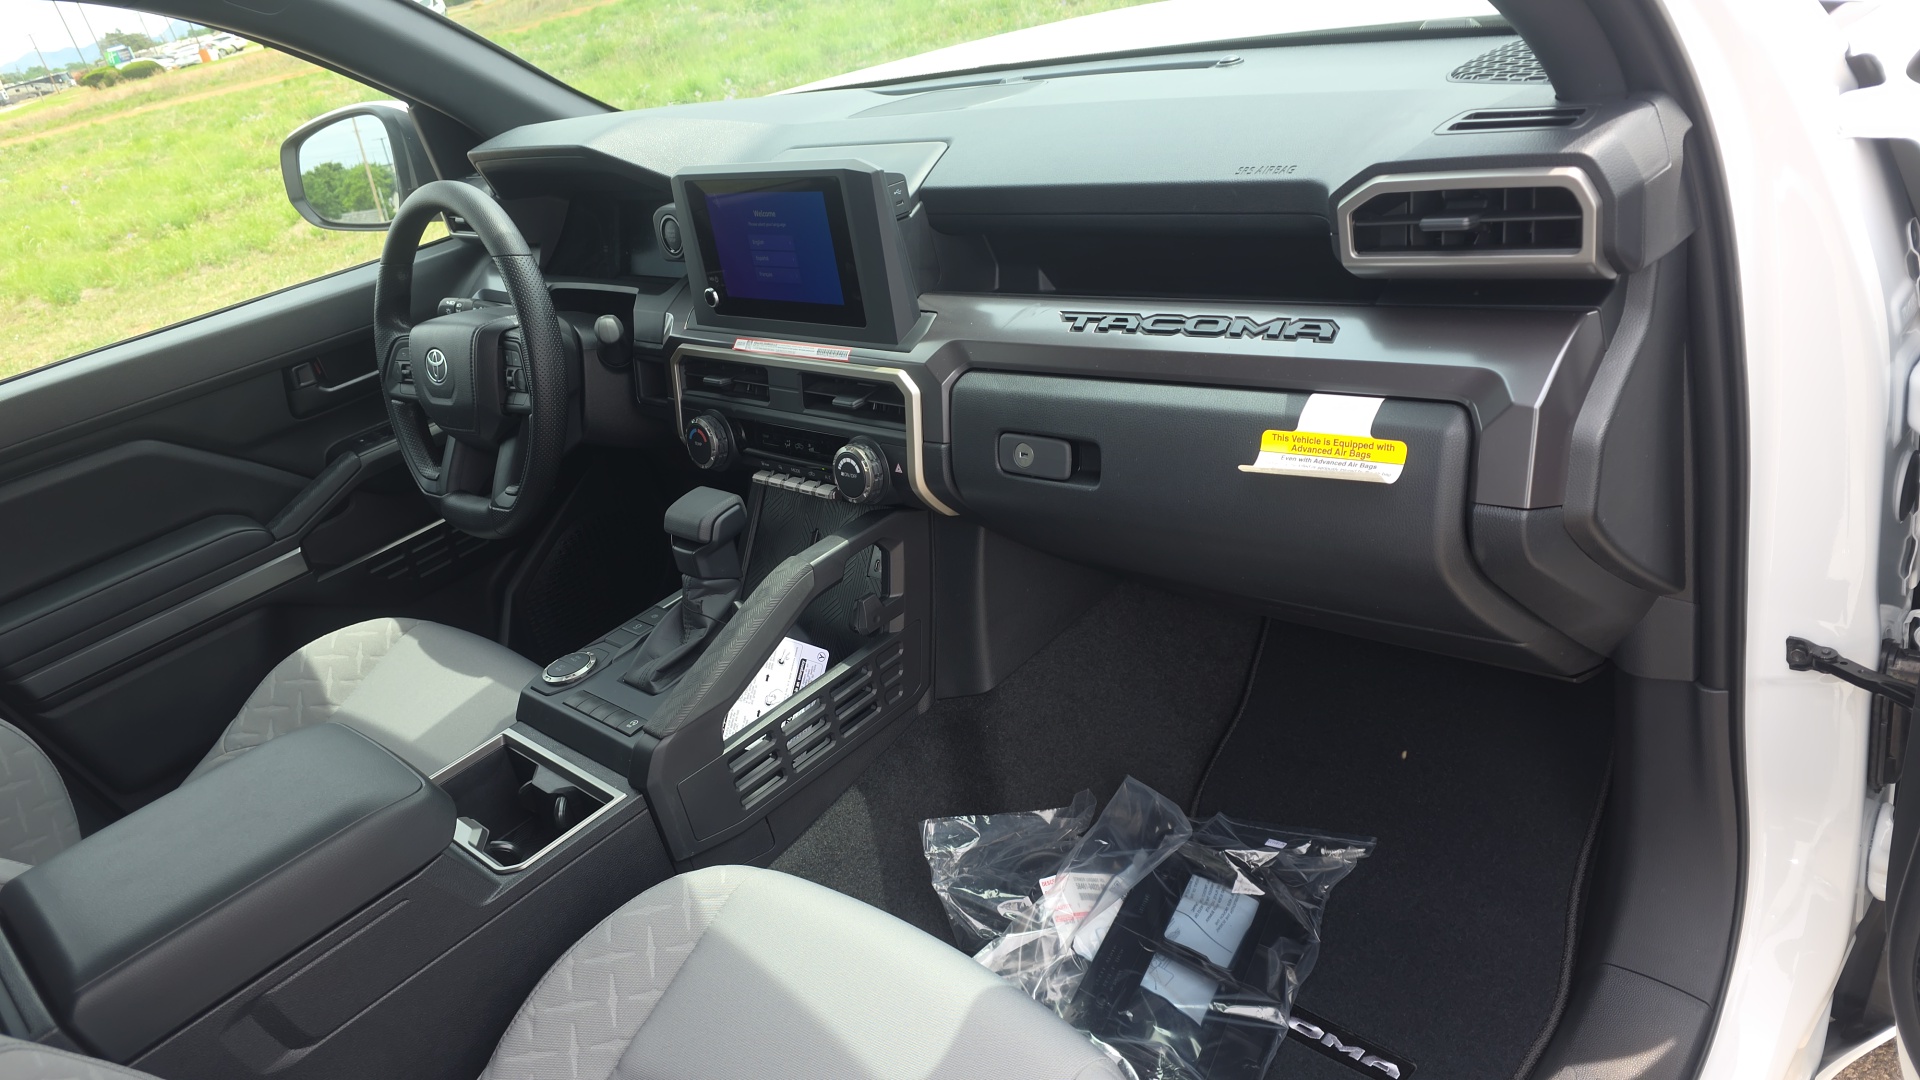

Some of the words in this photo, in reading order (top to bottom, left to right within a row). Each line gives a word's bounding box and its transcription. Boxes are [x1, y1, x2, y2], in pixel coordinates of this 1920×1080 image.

[1254, 164, 1298, 175] AIRBAG
[752, 209, 777, 218] Welcome
[1059, 310, 1340, 344] TACOMA
[1272, 433, 1289, 442] This
[1292, 434, 1321, 445] Vehicle
[1323, 438, 1331, 446] is
[1333, 438, 1374, 451] Equipped
[1377, 443, 1396, 452] with
[1291, 444, 1333, 455] Advanced
[1334, 448, 1347, 457] Air
[1349, 449, 1371, 460] Bags
[1313, 458, 1347, 467] Advanced
[1360, 462, 1378, 470] Bags
[1288, 1015, 1401, 1080] OMA
